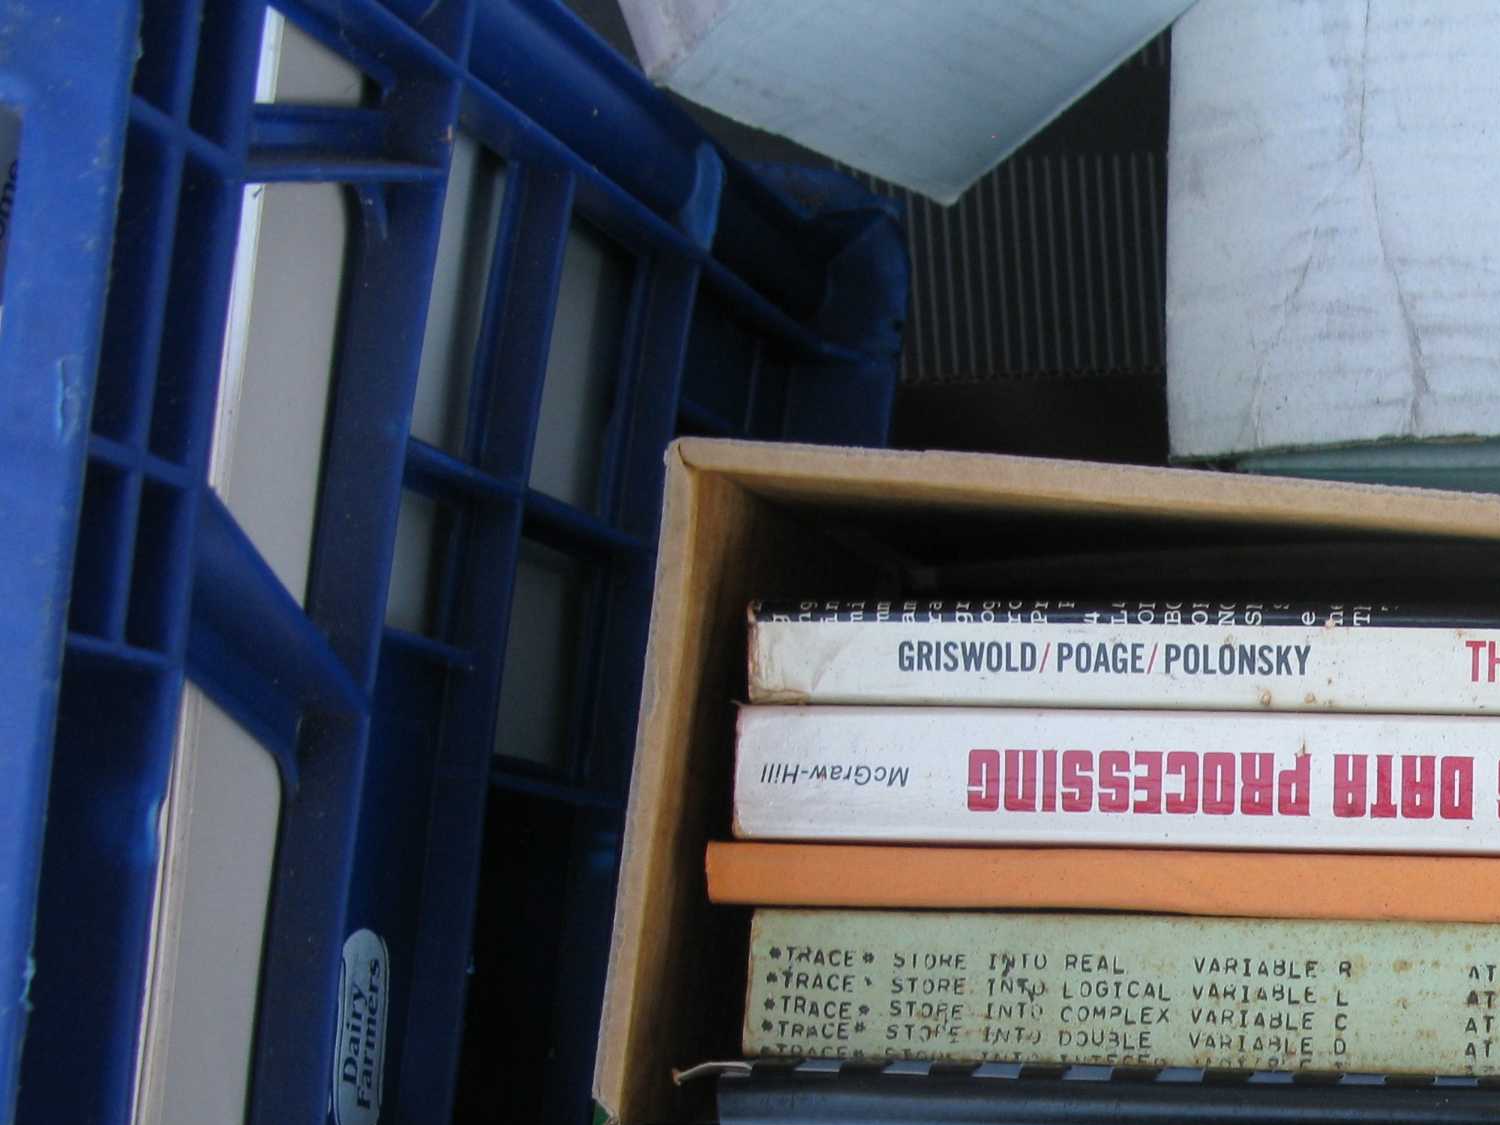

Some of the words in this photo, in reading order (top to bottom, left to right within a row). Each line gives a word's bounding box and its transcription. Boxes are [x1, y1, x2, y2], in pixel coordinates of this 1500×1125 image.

[759, 761, 910, 788] McGraw-Hill
[966, 748, 1313, 818] PROCESSING
[1332, 753, 1475, 821] DATA
[1064, 954, 1126, 974] REAL
[1193, 957, 1319, 979] VARIABLE
[1338, 960, 1352, 979] R
[1468, 964, 1497, 984] AT
[890, 977, 968, 996] STORE
[1062, 980, 1172, 1002] LOGICAL
[1192, 983, 1318, 1005] VARIABLE
[1336, 989, 1350, 1007] L
[1465, 990, 1497, 1009] AT
[342, 983, 369, 1085] Dairy
[356, 958, 381, 1110] Farmers
[1060, 1005, 1171, 1026] COMPLEX
[1191, 1009, 1316, 1031] VARIABLE
[1334, 1013, 1348, 1031] C
[1464, 1014, 1496, 1035] AT
[1058, 1030, 1152, 1051] DOUBLE
[1188, 1031, 1314, 1057] VARIABLE
[1333, 1037, 1347, 1056] D
[1463, 1041, 1494, 1062] AT
